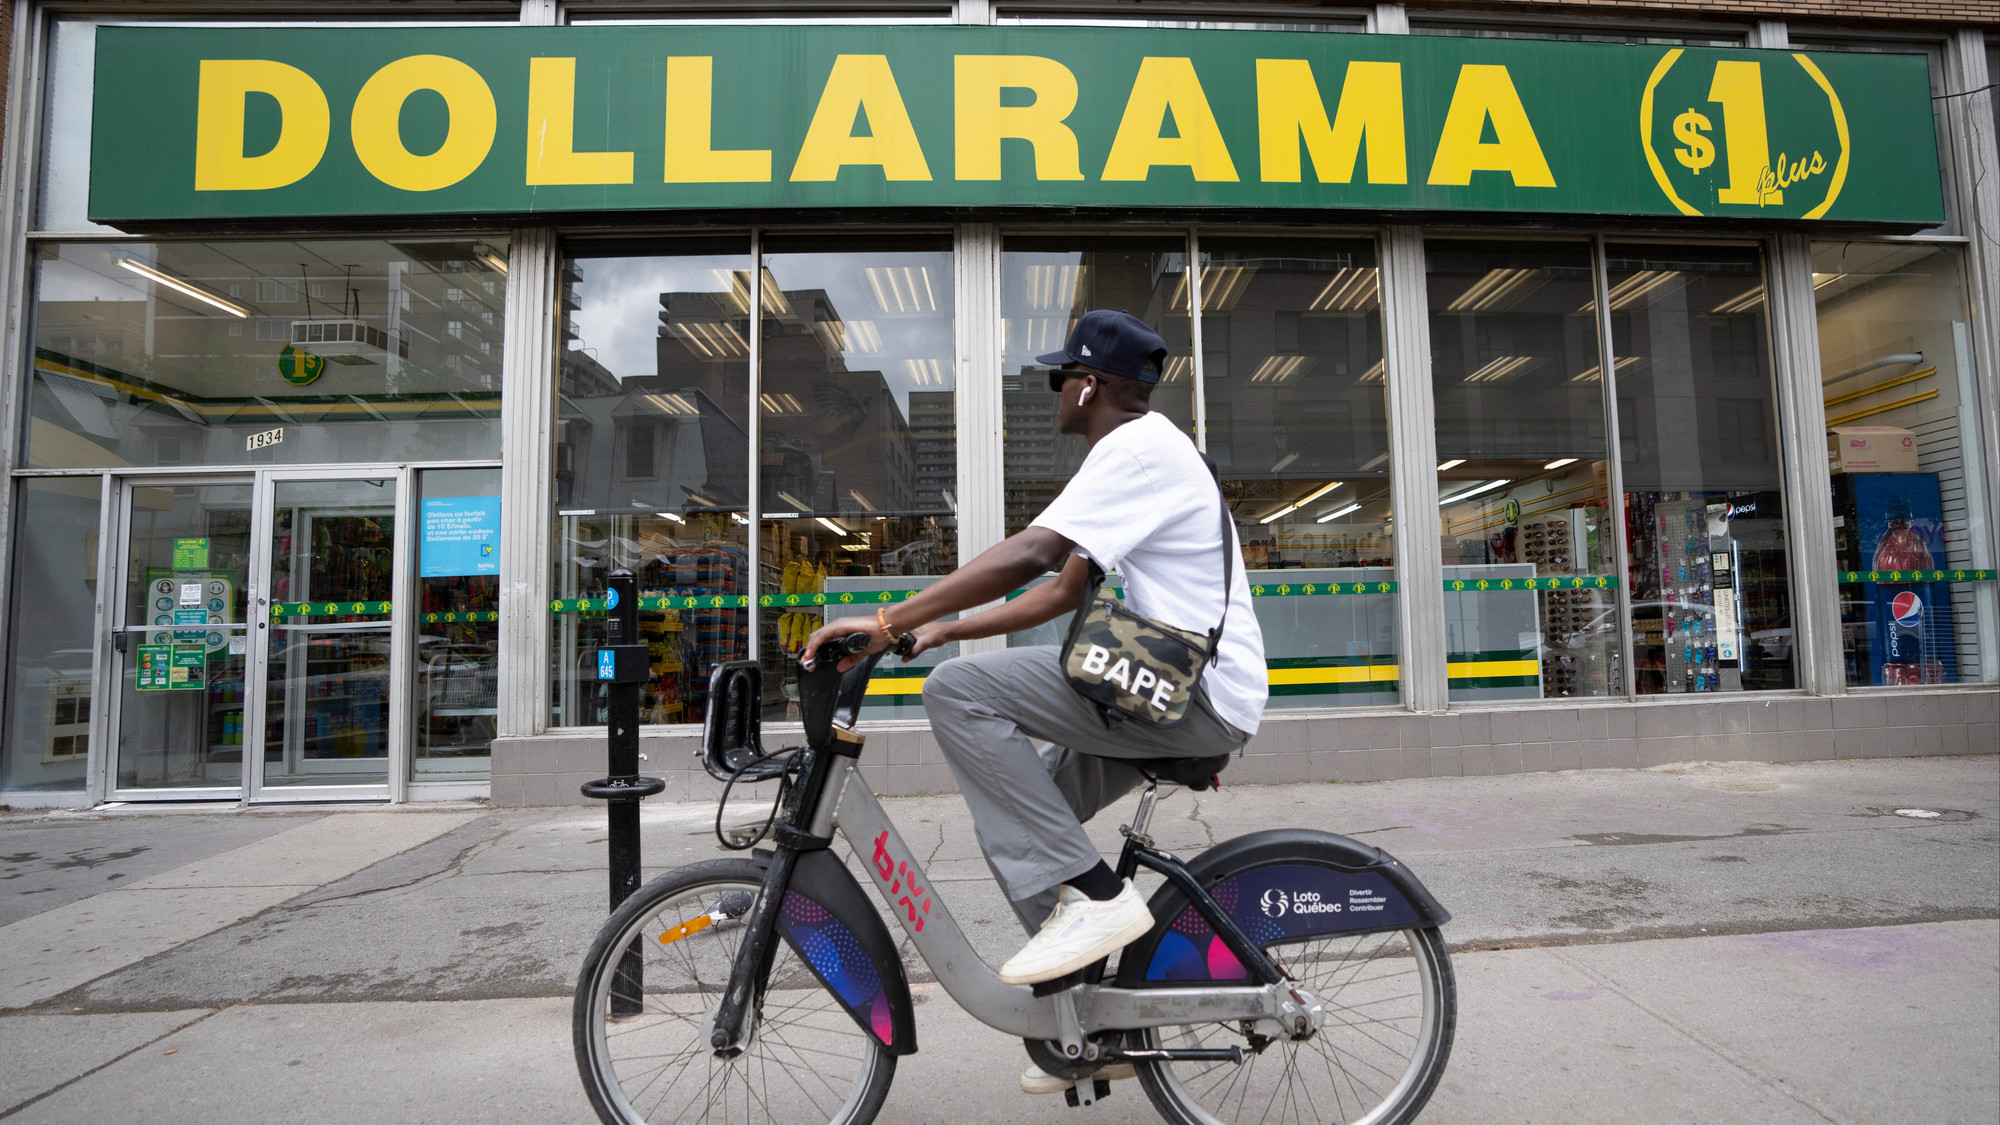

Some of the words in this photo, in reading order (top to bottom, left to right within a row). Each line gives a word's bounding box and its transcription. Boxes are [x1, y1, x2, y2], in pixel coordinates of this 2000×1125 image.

[195, 54, 1556, 192] DOLLARAMA
[1756, 150, 1827, 208] plus
[249, 429, 282, 449] 1934
[1735, 502, 1756, 516] pepsi
[1887, 622, 1900, 657] pepsi
[603, 651, 609, 664] A
[600, 665, 613, 678] 645
[1081, 645, 1175, 712] BAPE
[1293, 891, 1321, 903] Loto
[1293, 902, 1342, 914] Québec
[1349, 904, 1384, 912] Contribuer
